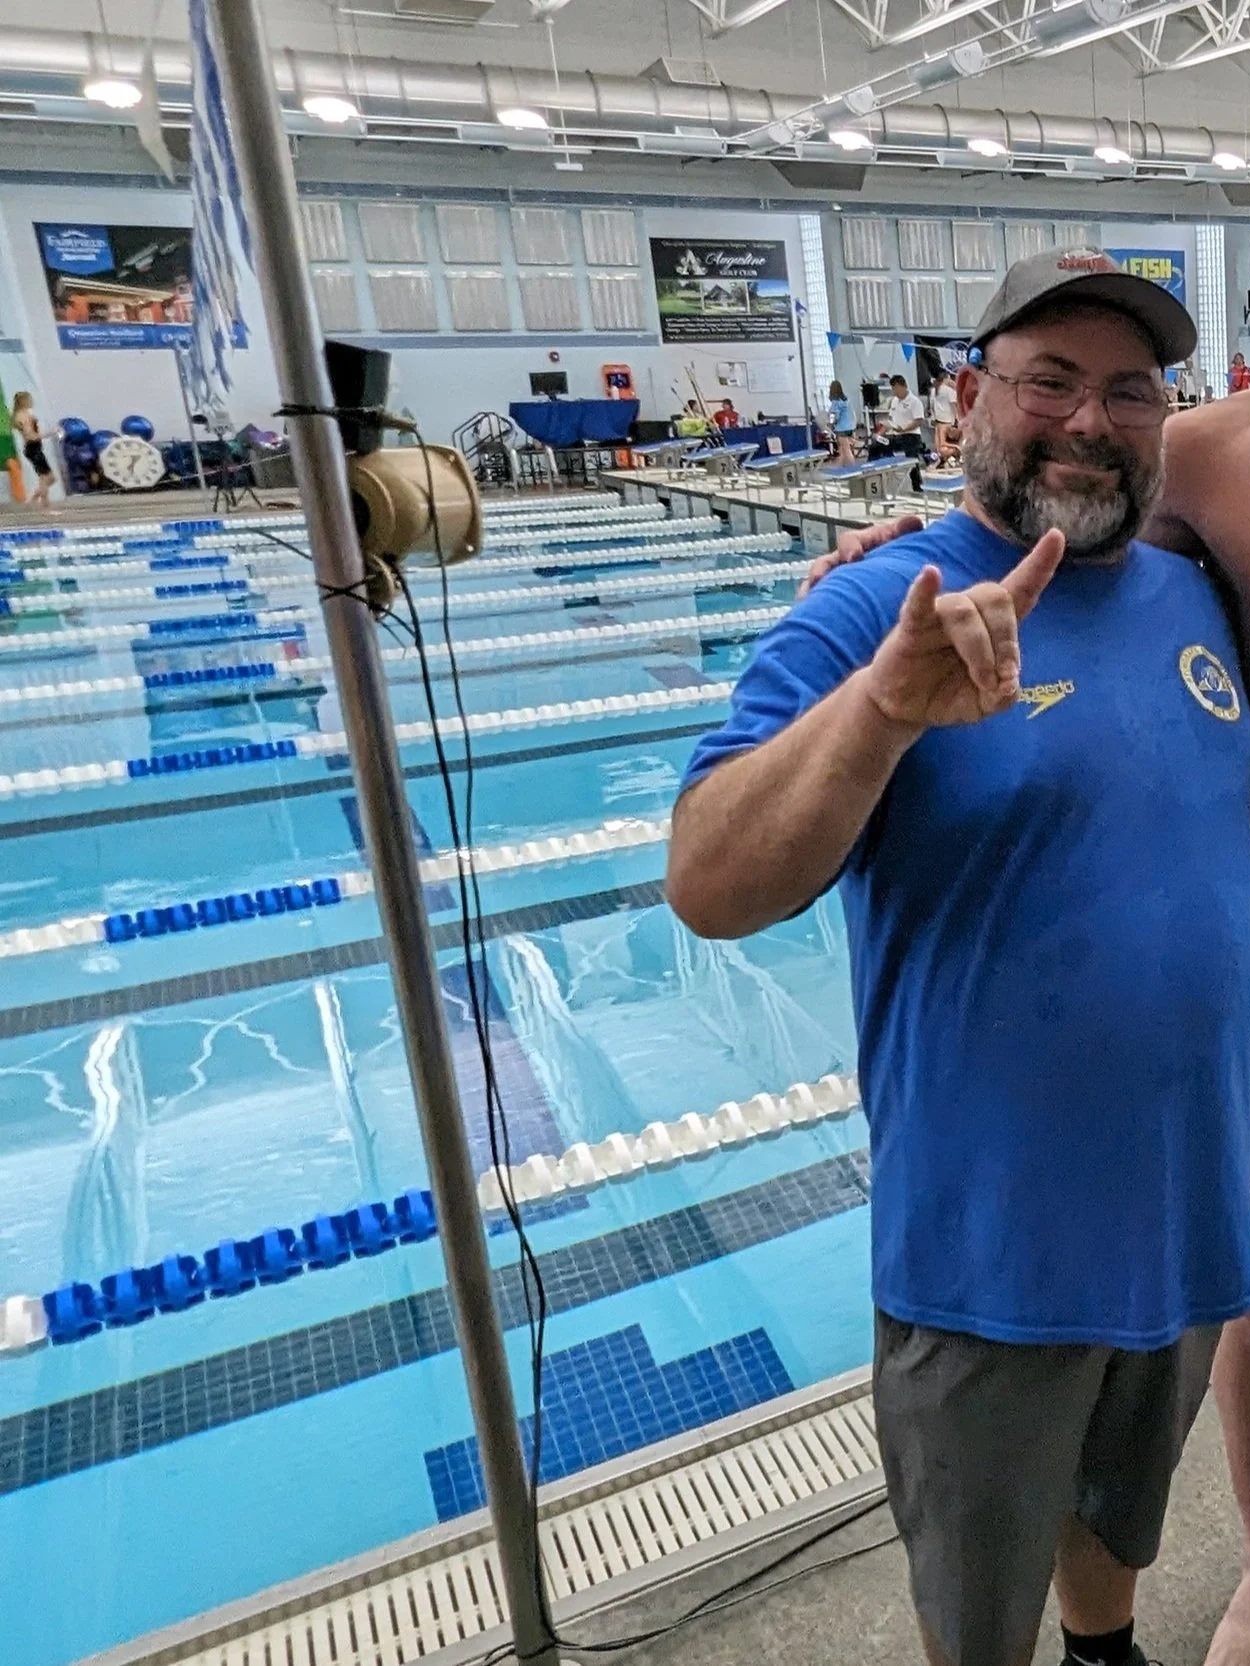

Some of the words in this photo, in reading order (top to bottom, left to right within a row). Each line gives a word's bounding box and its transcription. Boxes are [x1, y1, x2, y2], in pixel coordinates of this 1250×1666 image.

[705, 251, 767, 271] Augustine
[1129, 257, 1172, 279] FISH
[870, 482, 878, 495] 5
